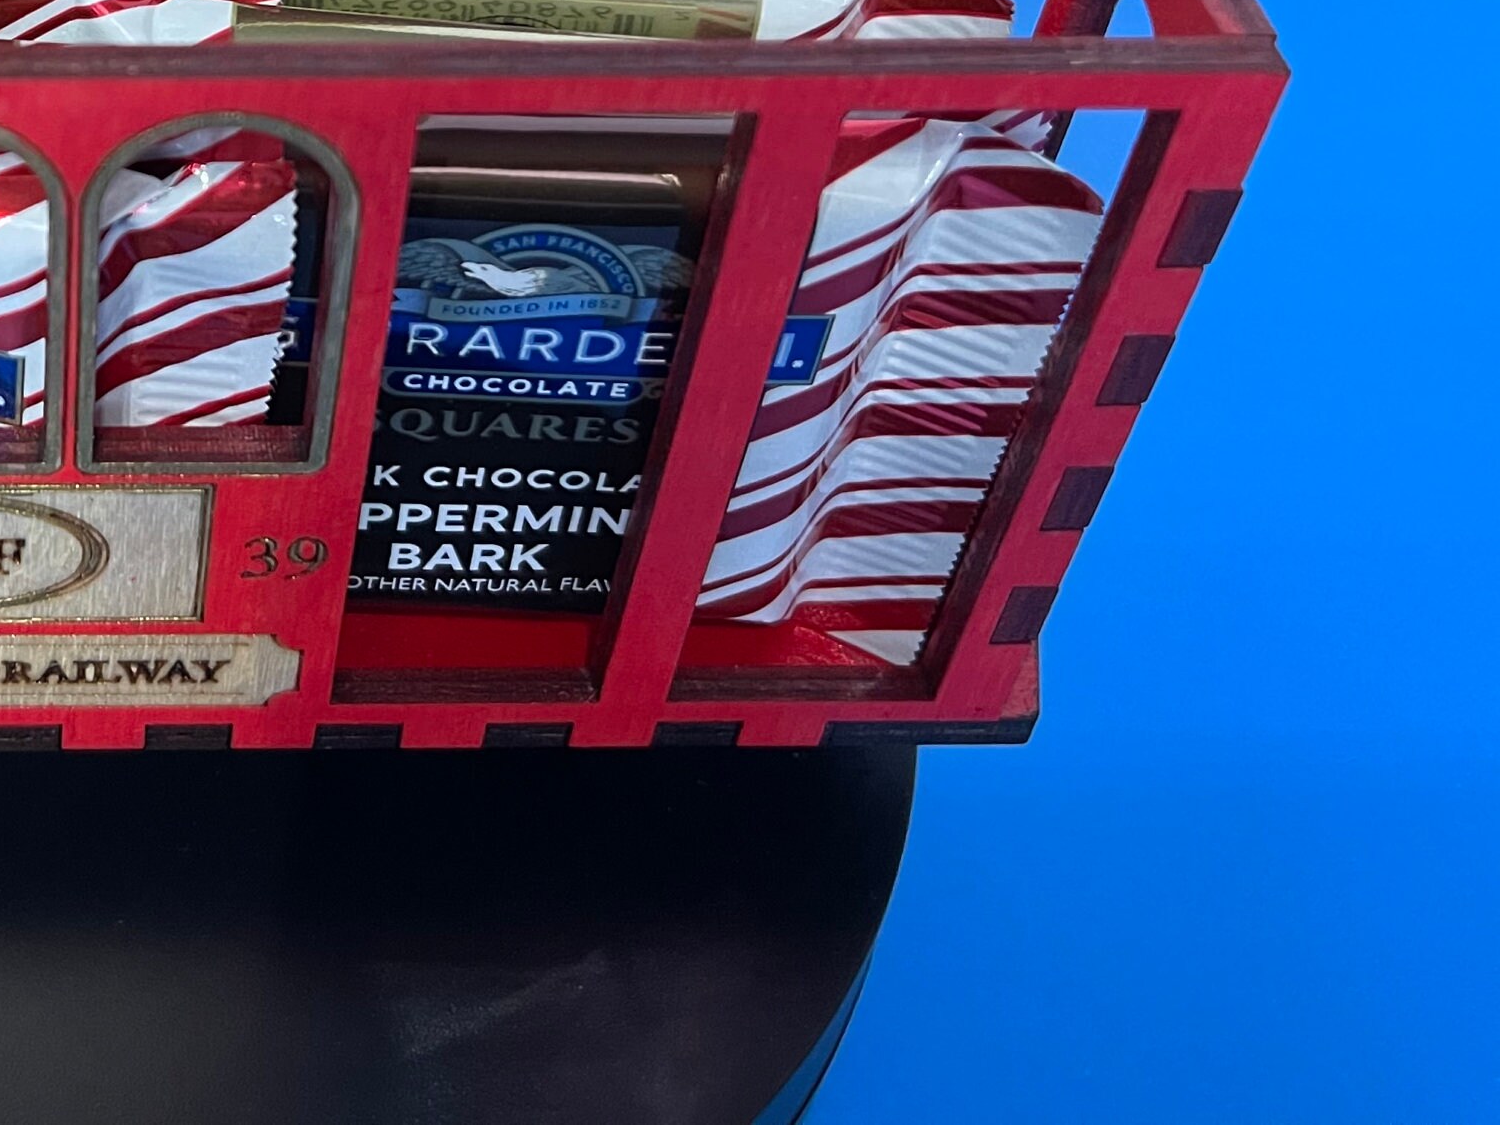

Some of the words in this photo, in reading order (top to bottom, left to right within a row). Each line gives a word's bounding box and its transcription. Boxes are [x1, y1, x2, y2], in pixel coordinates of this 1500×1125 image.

[490, 234, 537, 254] SAN
[546, 235, 636, 292] FRANCISCO
[442, 301, 542, 317] FOUNDED
[547, 300, 570, 311] IN
[402, 374, 631, 398] CHOCOLATE
[239, 536, 330, 581] 39
[387, 542, 550, 572] BARK
[346, 575, 426, 592] OTHER
[434, 577, 553, 593] NATURAL
[0, 659, 232, 686] RAILWAY
